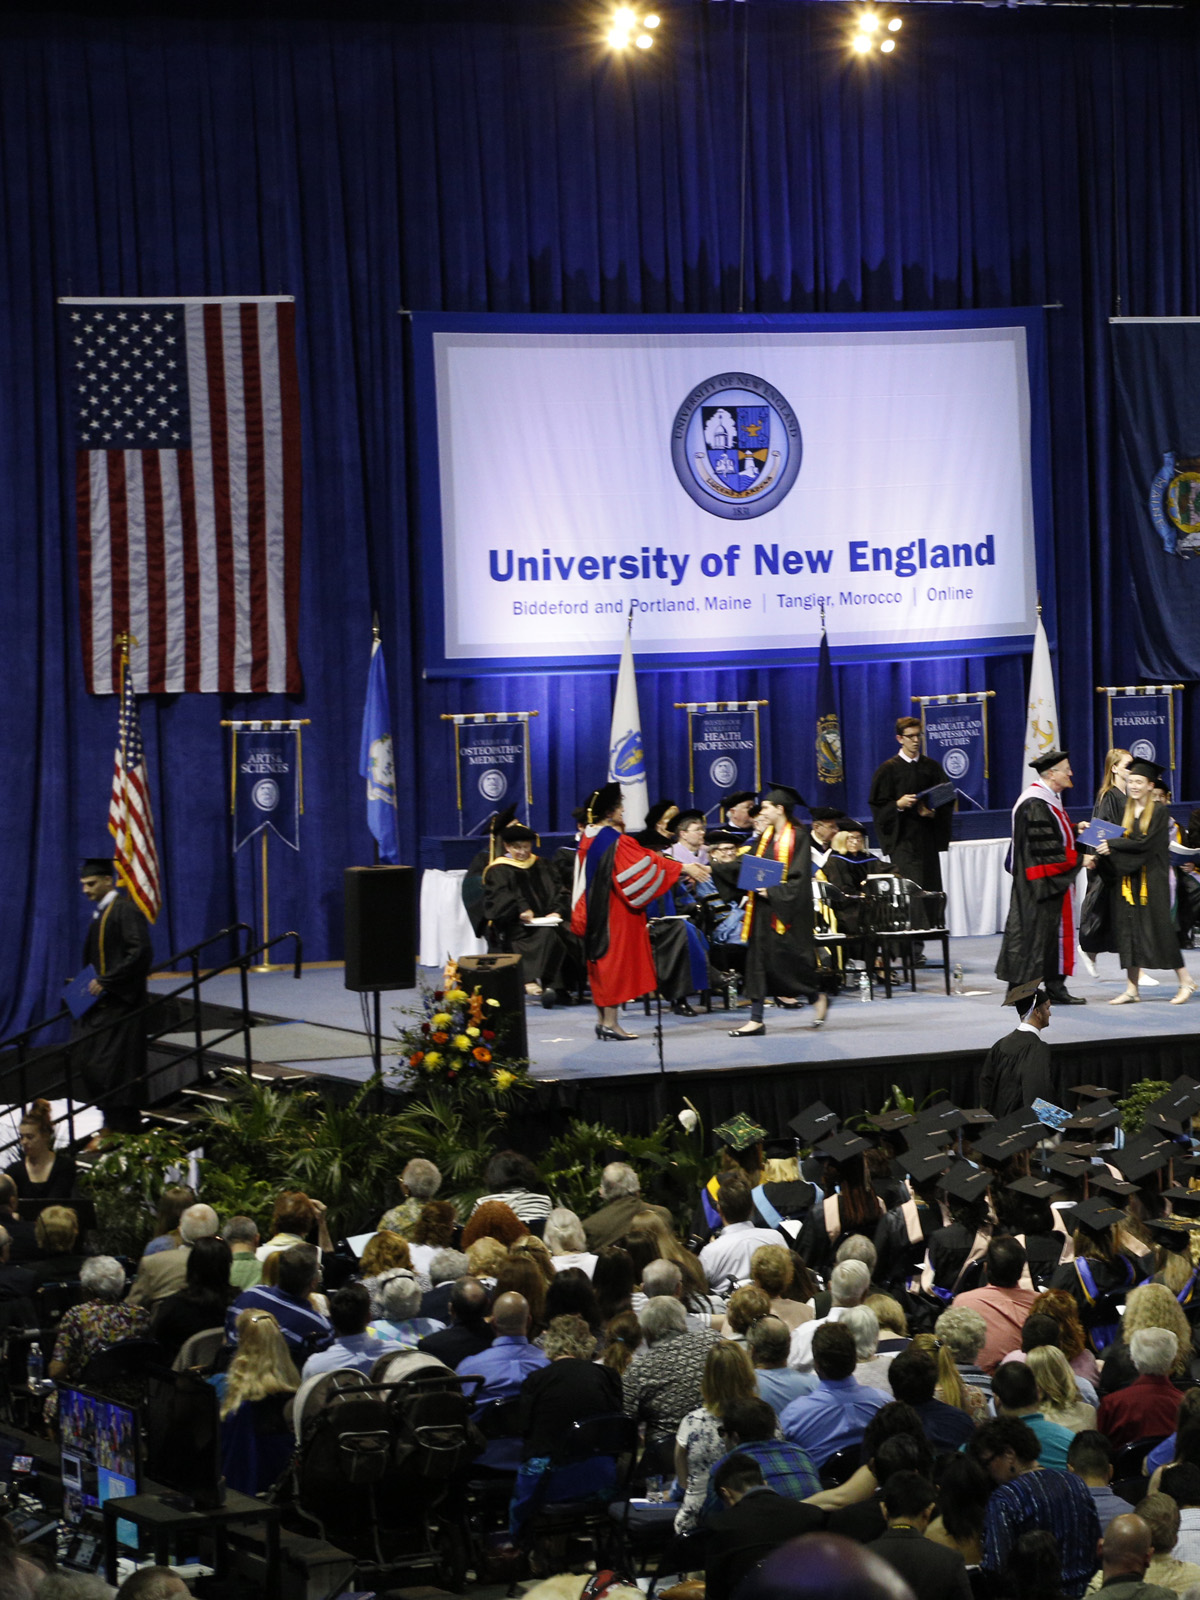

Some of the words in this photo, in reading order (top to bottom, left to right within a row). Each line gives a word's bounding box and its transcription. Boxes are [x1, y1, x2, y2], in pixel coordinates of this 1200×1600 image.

[488, 546, 691, 587] University
[701, 544, 740, 578] of
[754, 542, 834, 576] New
[849, 534, 996, 578] England
[512, 599, 590, 616] Biddeford
[594, 599, 624, 614] and
[630, 597, 700, 615] Portland,
[704, 595, 752, 612] Maine
[776, 591, 834, 610] Tangier,
[839, 589, 903, 606] Morocco
[926, 586, 974, 603] Online
[926, 721, 965, 731] GRADUATE
[966, 720, 982, 729] AND
[1113, 715, 1166, 726] PHARMACY
[703, 731, 742, 741] HEALTH
[928, 728, 980, 740] PROFESSIONAL
[693, 740, 754, 751] PROFESSIONS
[939, 737, 971, 747] STUDIES
[460, 744, 523, 756] OSTEOPATHIC
[468, 754, 515, 765] MEDICINE
[241, 763, 290, 774] SCIENCES
